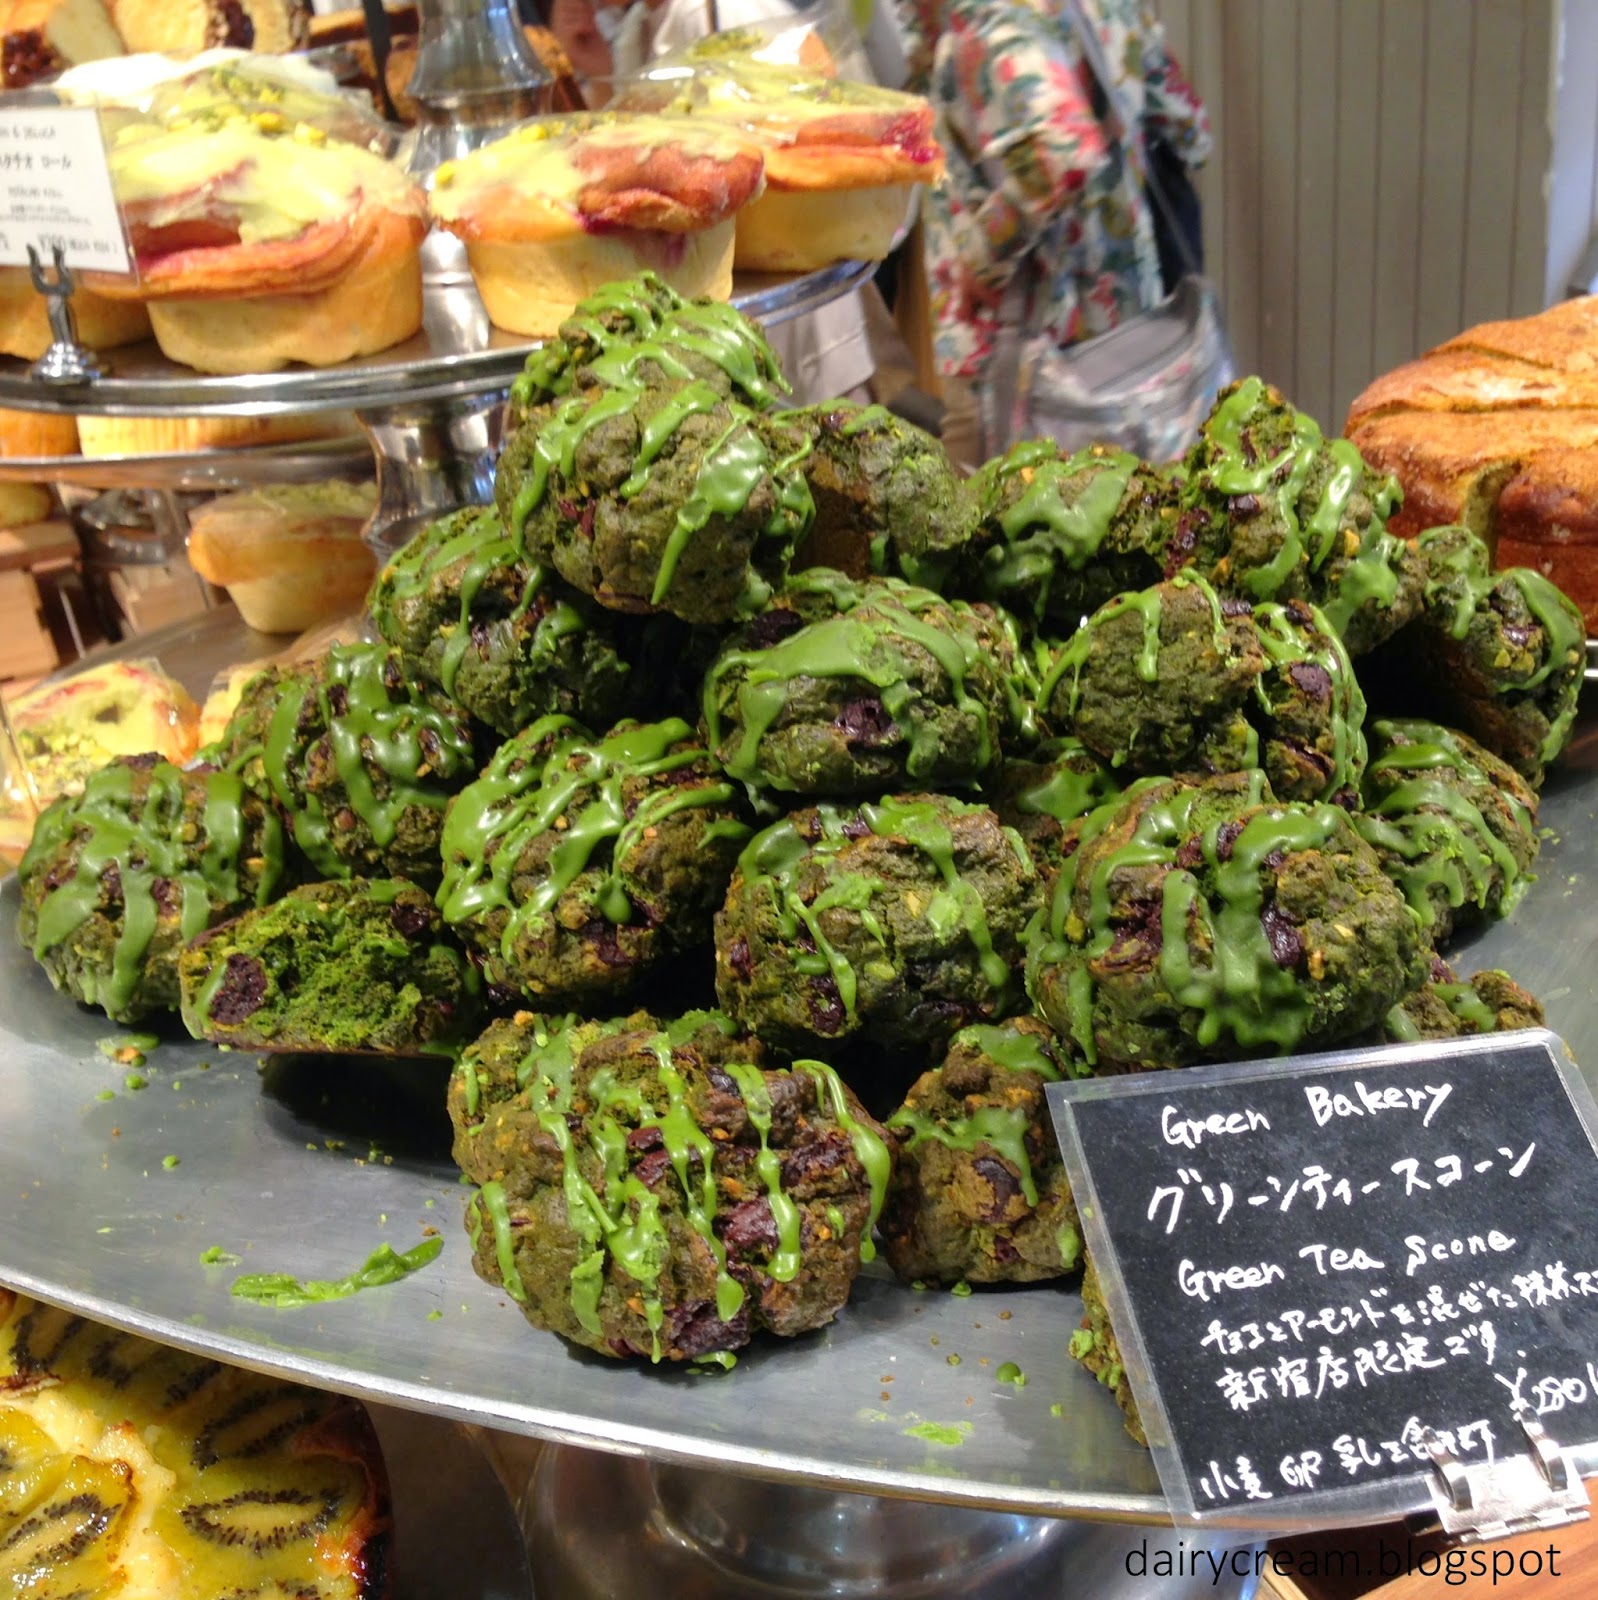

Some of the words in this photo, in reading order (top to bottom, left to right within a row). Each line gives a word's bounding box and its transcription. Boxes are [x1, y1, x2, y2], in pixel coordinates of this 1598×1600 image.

[1162, 1106, 1270, 1149] Green
[1304, 1082, 1452, 1127] Bakery
[1148, 1143, 1535, 1234] グリーンティースコーン
[1178, 1259, 1284, 1301] Green
[1300, 1244, 1384, 1274] Tea
[1405, 1230, 1516, 1275] Scone
[1200, 1456, 1273, 1499] 小麦
[1280, 1450, 1322, 1488] 卵
